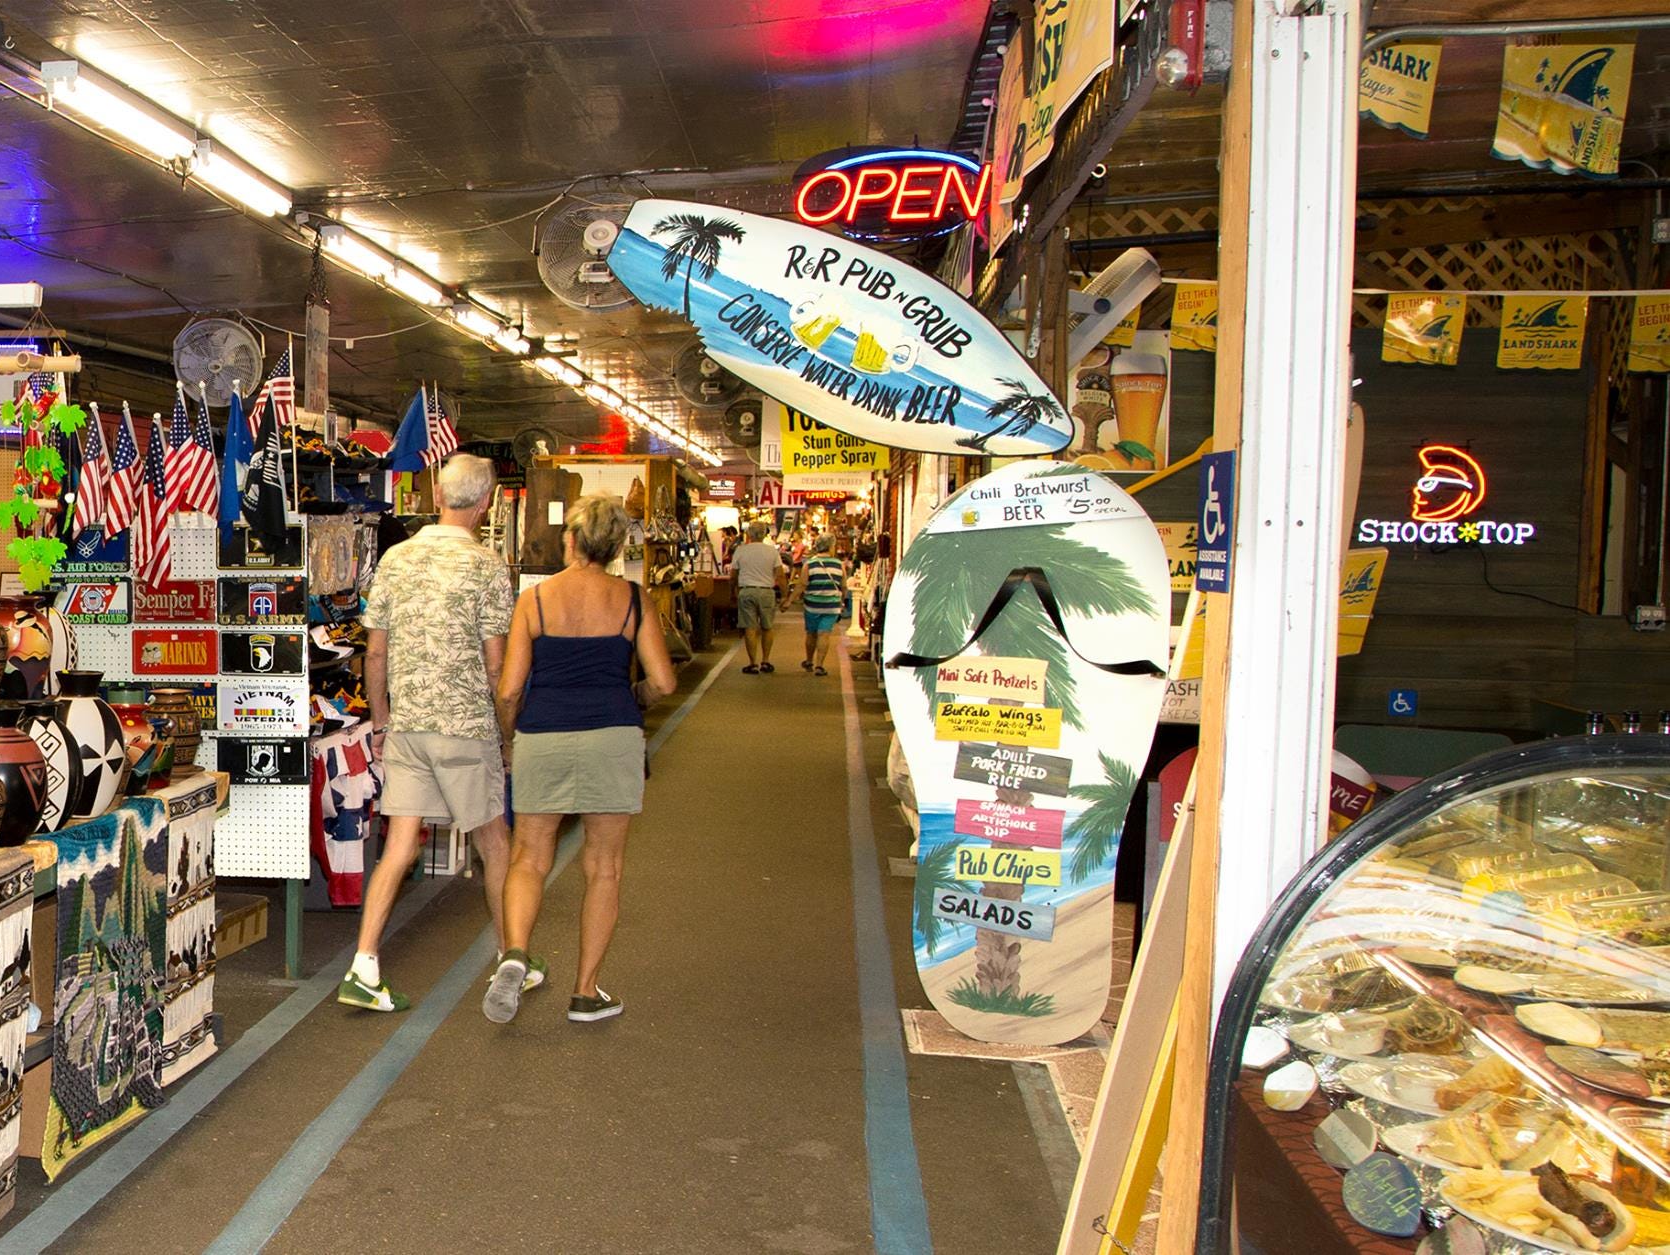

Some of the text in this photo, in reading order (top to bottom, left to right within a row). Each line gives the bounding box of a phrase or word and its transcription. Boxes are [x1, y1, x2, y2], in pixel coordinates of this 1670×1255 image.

[797, 166, 991, 223] OPEN
[784, 245, 841, 284] R&R
[840, 257, 897, 301] PUB
[902, 295, 975, 359] GRUB
[1178, 291, 1191, 300] LET
[1194, 290, 1208, 299] THE
[1178, 301, 1204, 311] BEGIN!
[1638, 305, 1656, 316] LET
[1503, 339, 1578, 349] LANDSHARK
[716, 292, 962, 427] CONSERVE WATER DRINK BEER
[803, 433, 867, 450] Stun Guns
[794, 450, 877, 468] Pepper Spray
[760, 480, 805, 506] ATM
[970, 477, 1092, 501] Chili Bratwurst
[1003, 505, 1046, 522] BEER
[1358, 518, 1535, 545] SHOCK TOP
[1198, 550, 1227, 563] ASSISTANCE
[66, 562, 87, 573] AIR
[89, 562, 128, 573] FORCE
[1198, 567, 1225, 581] AVAILABLE
[135, 583, 217, 618] Semper Fi
[67, 613, 97, 625] COAST
[99, 613, 128, 624] GUARD
[218, 614, 306, 625] U.S. ARMY
[160, 641, 208, 666] MARINES
[937, 667, 1039, 691] Mini Soft Pretzels
[234, 691, 295, 707] VIETNAM
[941, 704, 990, 717] Buffalo
[991, 748, 1035, 764] ADULT
[971, 756, 1048, 780] PORK FRIED
[987, 771, 1023, 790] RICE
[979, 801, 1027, 816] SPINACH
[993, 810, 1011, 819] AND
[971, 813, 1038, 832] ARTICHOKE
[983, 825, 1010, 838] DIP
[958, 849, 1051, 886] Pub Chips
[938, 894, 1034, 930] SALADS
